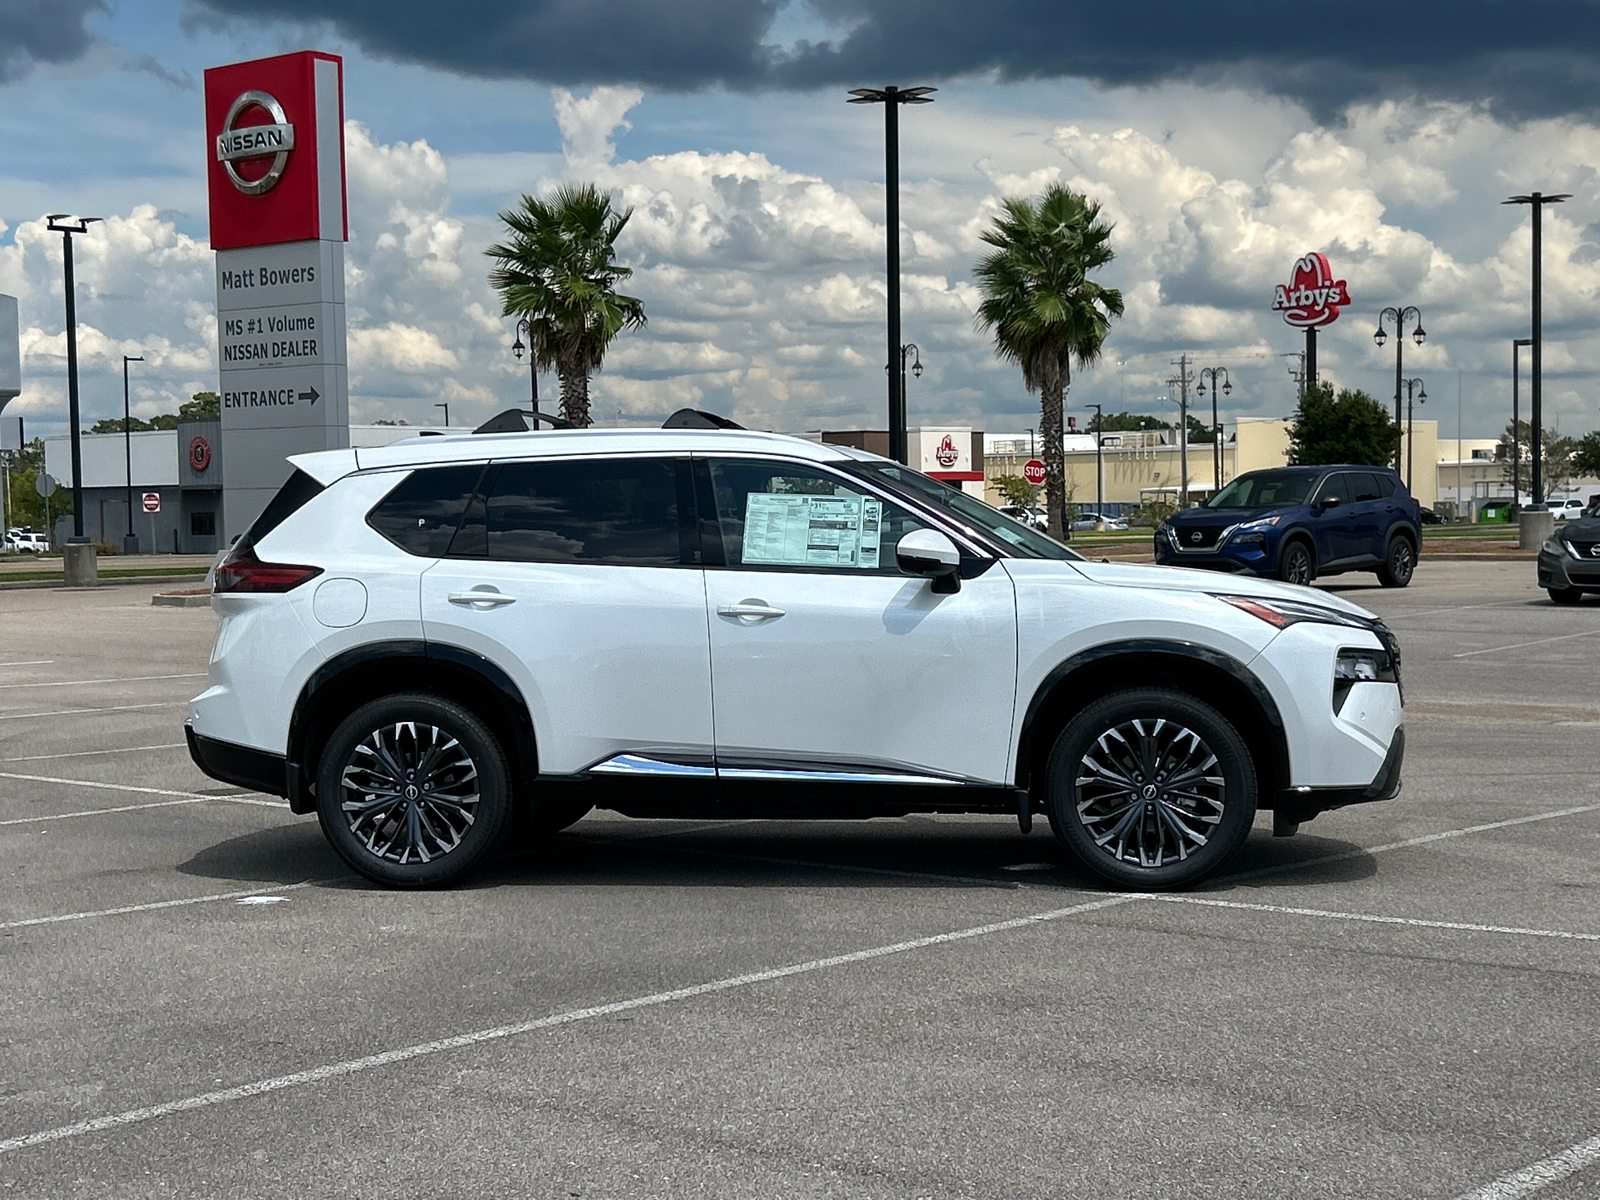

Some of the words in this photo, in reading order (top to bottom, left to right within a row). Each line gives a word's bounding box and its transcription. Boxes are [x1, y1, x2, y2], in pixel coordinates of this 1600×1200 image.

[220, 129, 283, 154] NISSAN
[222, 269, 255, 290] Matt
[259, 266, 315, 286] Bowers
[225, 319, 243, 336] MS
[248, 318, 263, 334] #1
[268, 315, 315, 332] Volume
[224, 343, 268, 361] NISSAN
[272, 339, 318, 358] DEALER
[224, 389, 295, 408] ENTRANCE
[1025, 466, 1045, 477] STOP
[418, 518, 426, 527] P
